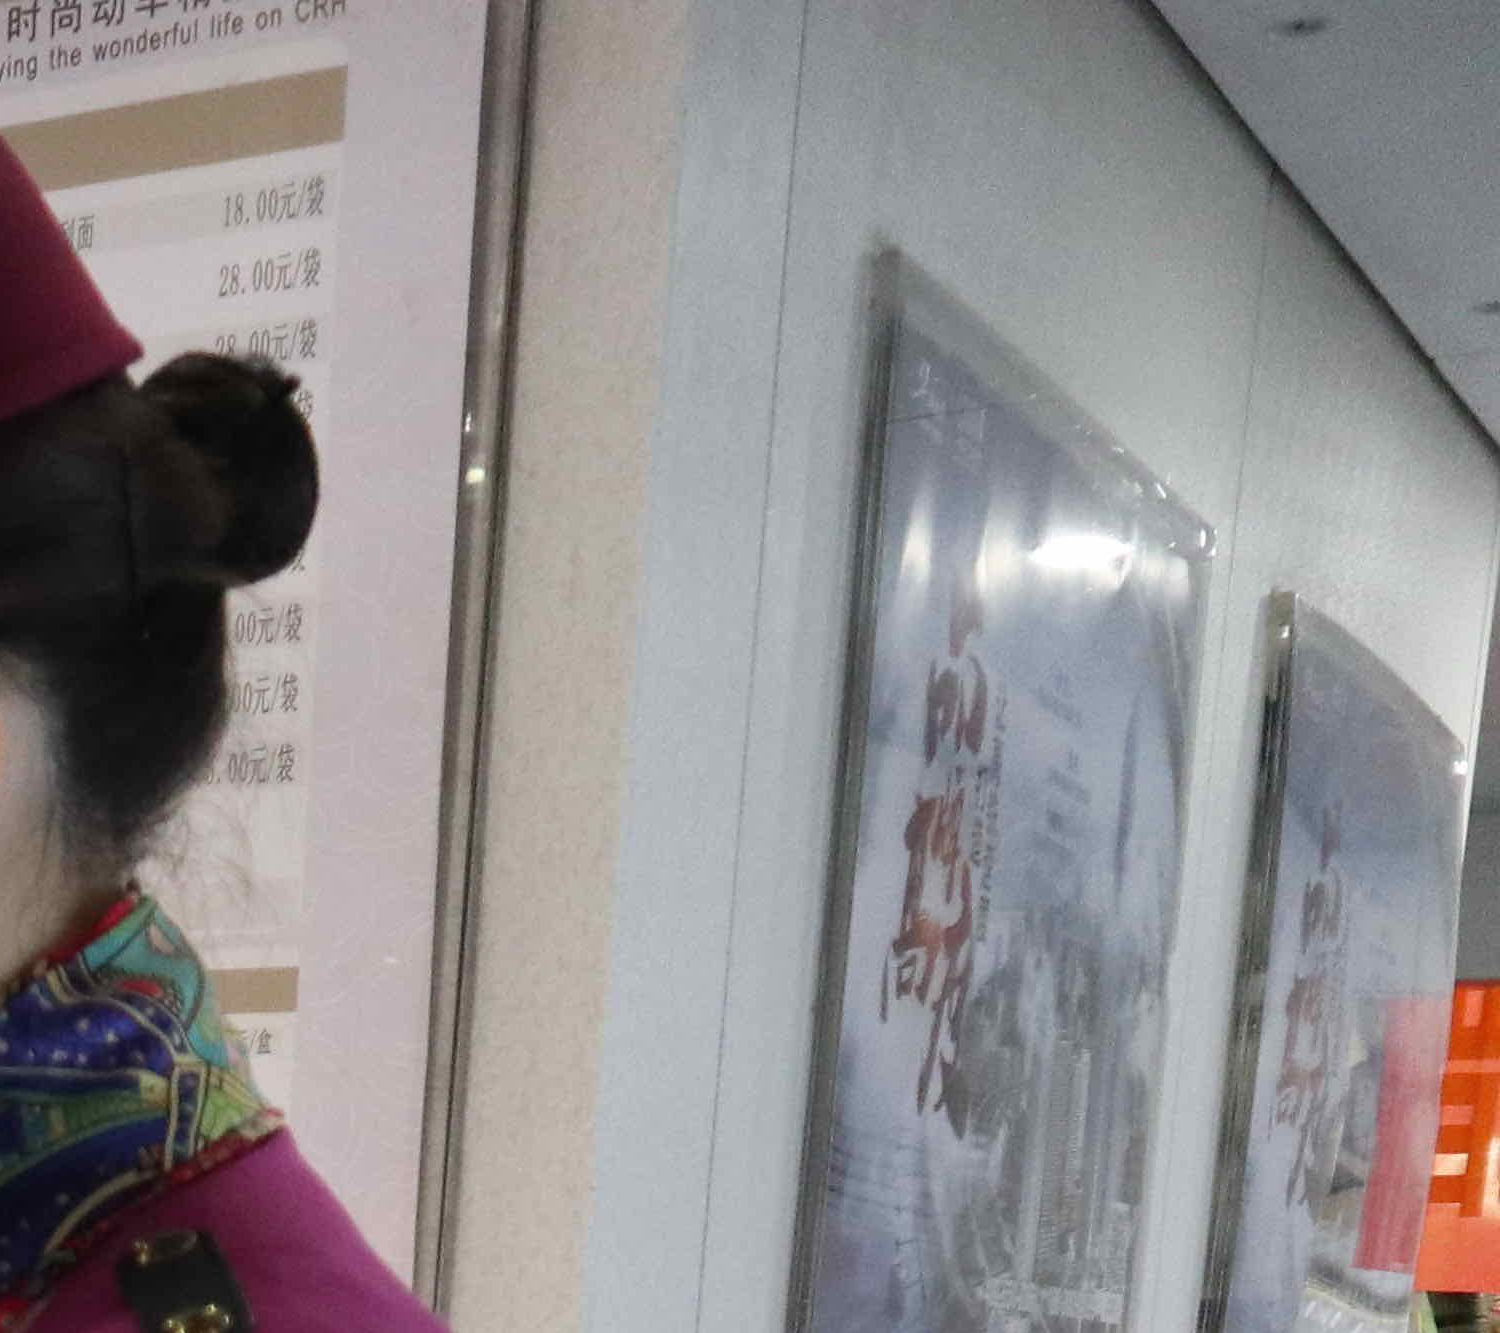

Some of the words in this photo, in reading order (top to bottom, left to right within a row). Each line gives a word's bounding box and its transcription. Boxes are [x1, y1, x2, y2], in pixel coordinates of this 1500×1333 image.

[49, 44, 83, 71] the
[94, 18, 199, 61] wonderful
[210, 12, 245, 39] life
[255, 7, 283, 31] on
[295, 0, 346, 24] CRH
[223, 176, 325, 228] 18.00元/袋
[219, 248, 322, 297] 28.00元/袋
[215, 319, 317, 359] 2800元/袋
[235, 603, 302, 644] 00元/袋
[231, 673, 299, 714] 00元/袋
